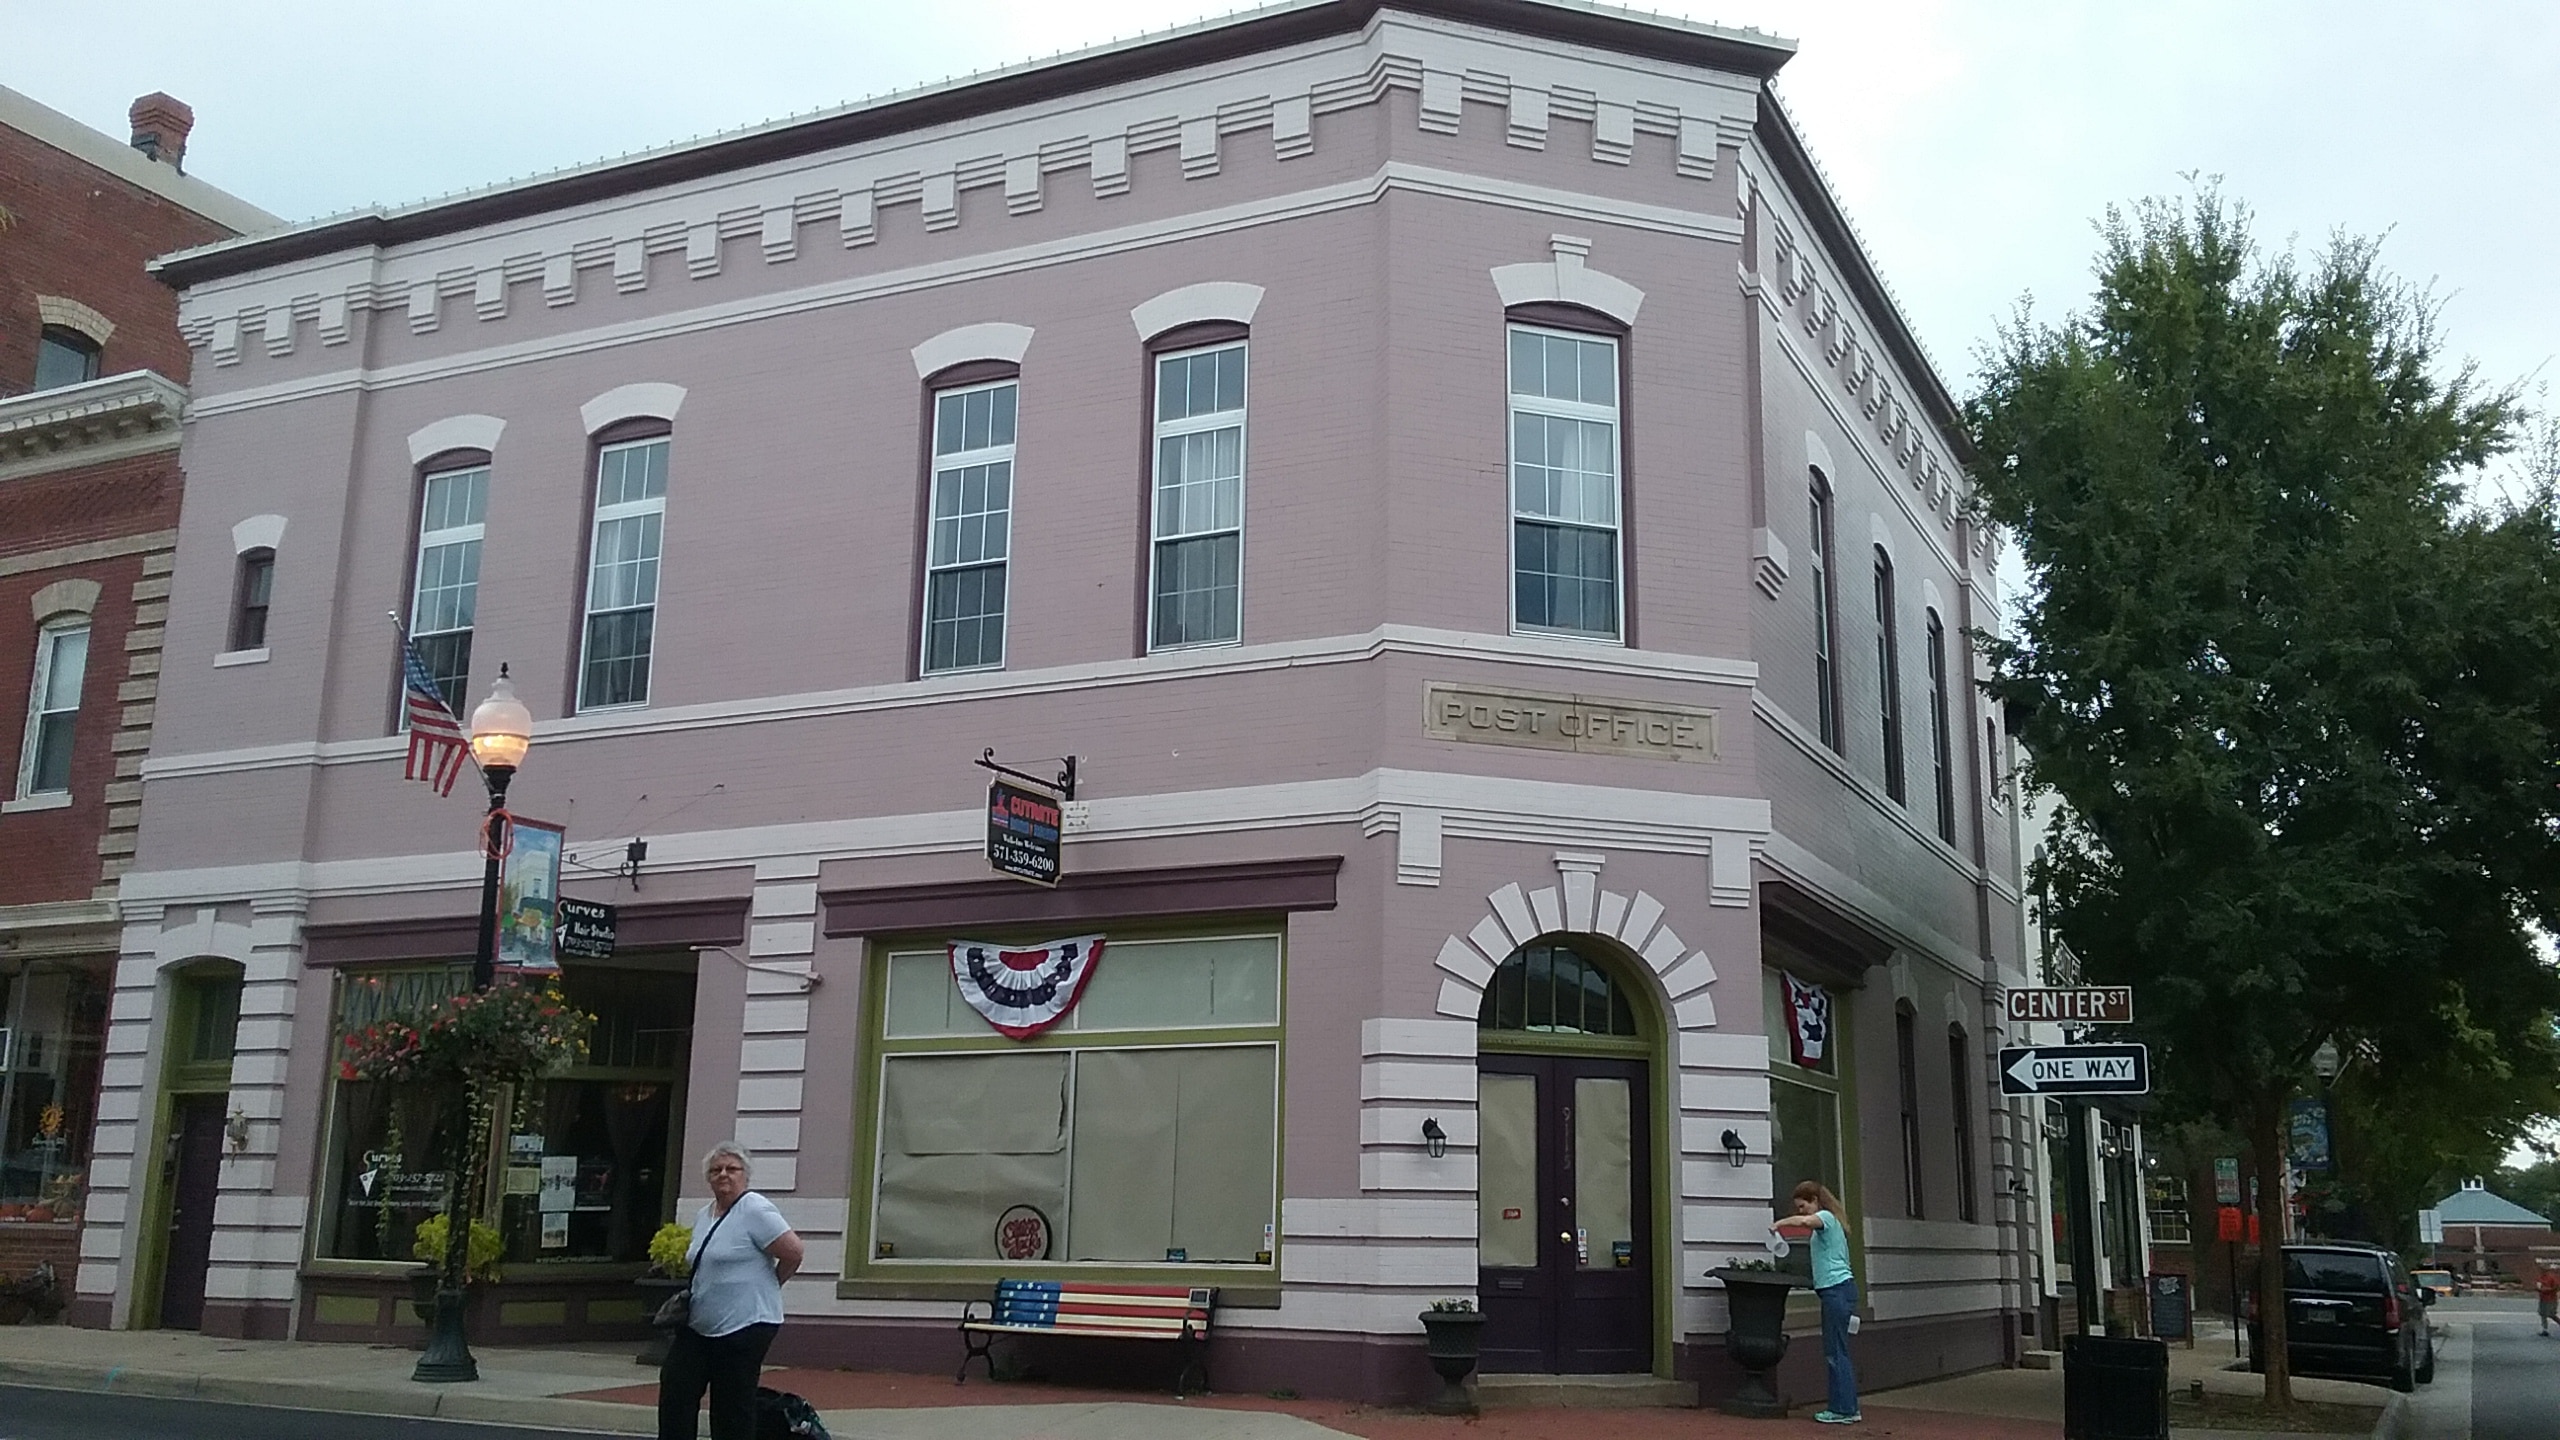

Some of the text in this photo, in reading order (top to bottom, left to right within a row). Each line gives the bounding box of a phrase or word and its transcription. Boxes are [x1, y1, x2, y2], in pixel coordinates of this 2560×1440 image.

[1440, 702, 1547, 734] POST
[993, 843, 1055, 873] 571-359-6200
[558, 900, 605, 922] Curves
[591, 923, 615, 940] Studio
[2010, 991, 2126, 1018] CENTER ST
[2032, 1059, 2131, 1080] ONE WAY
